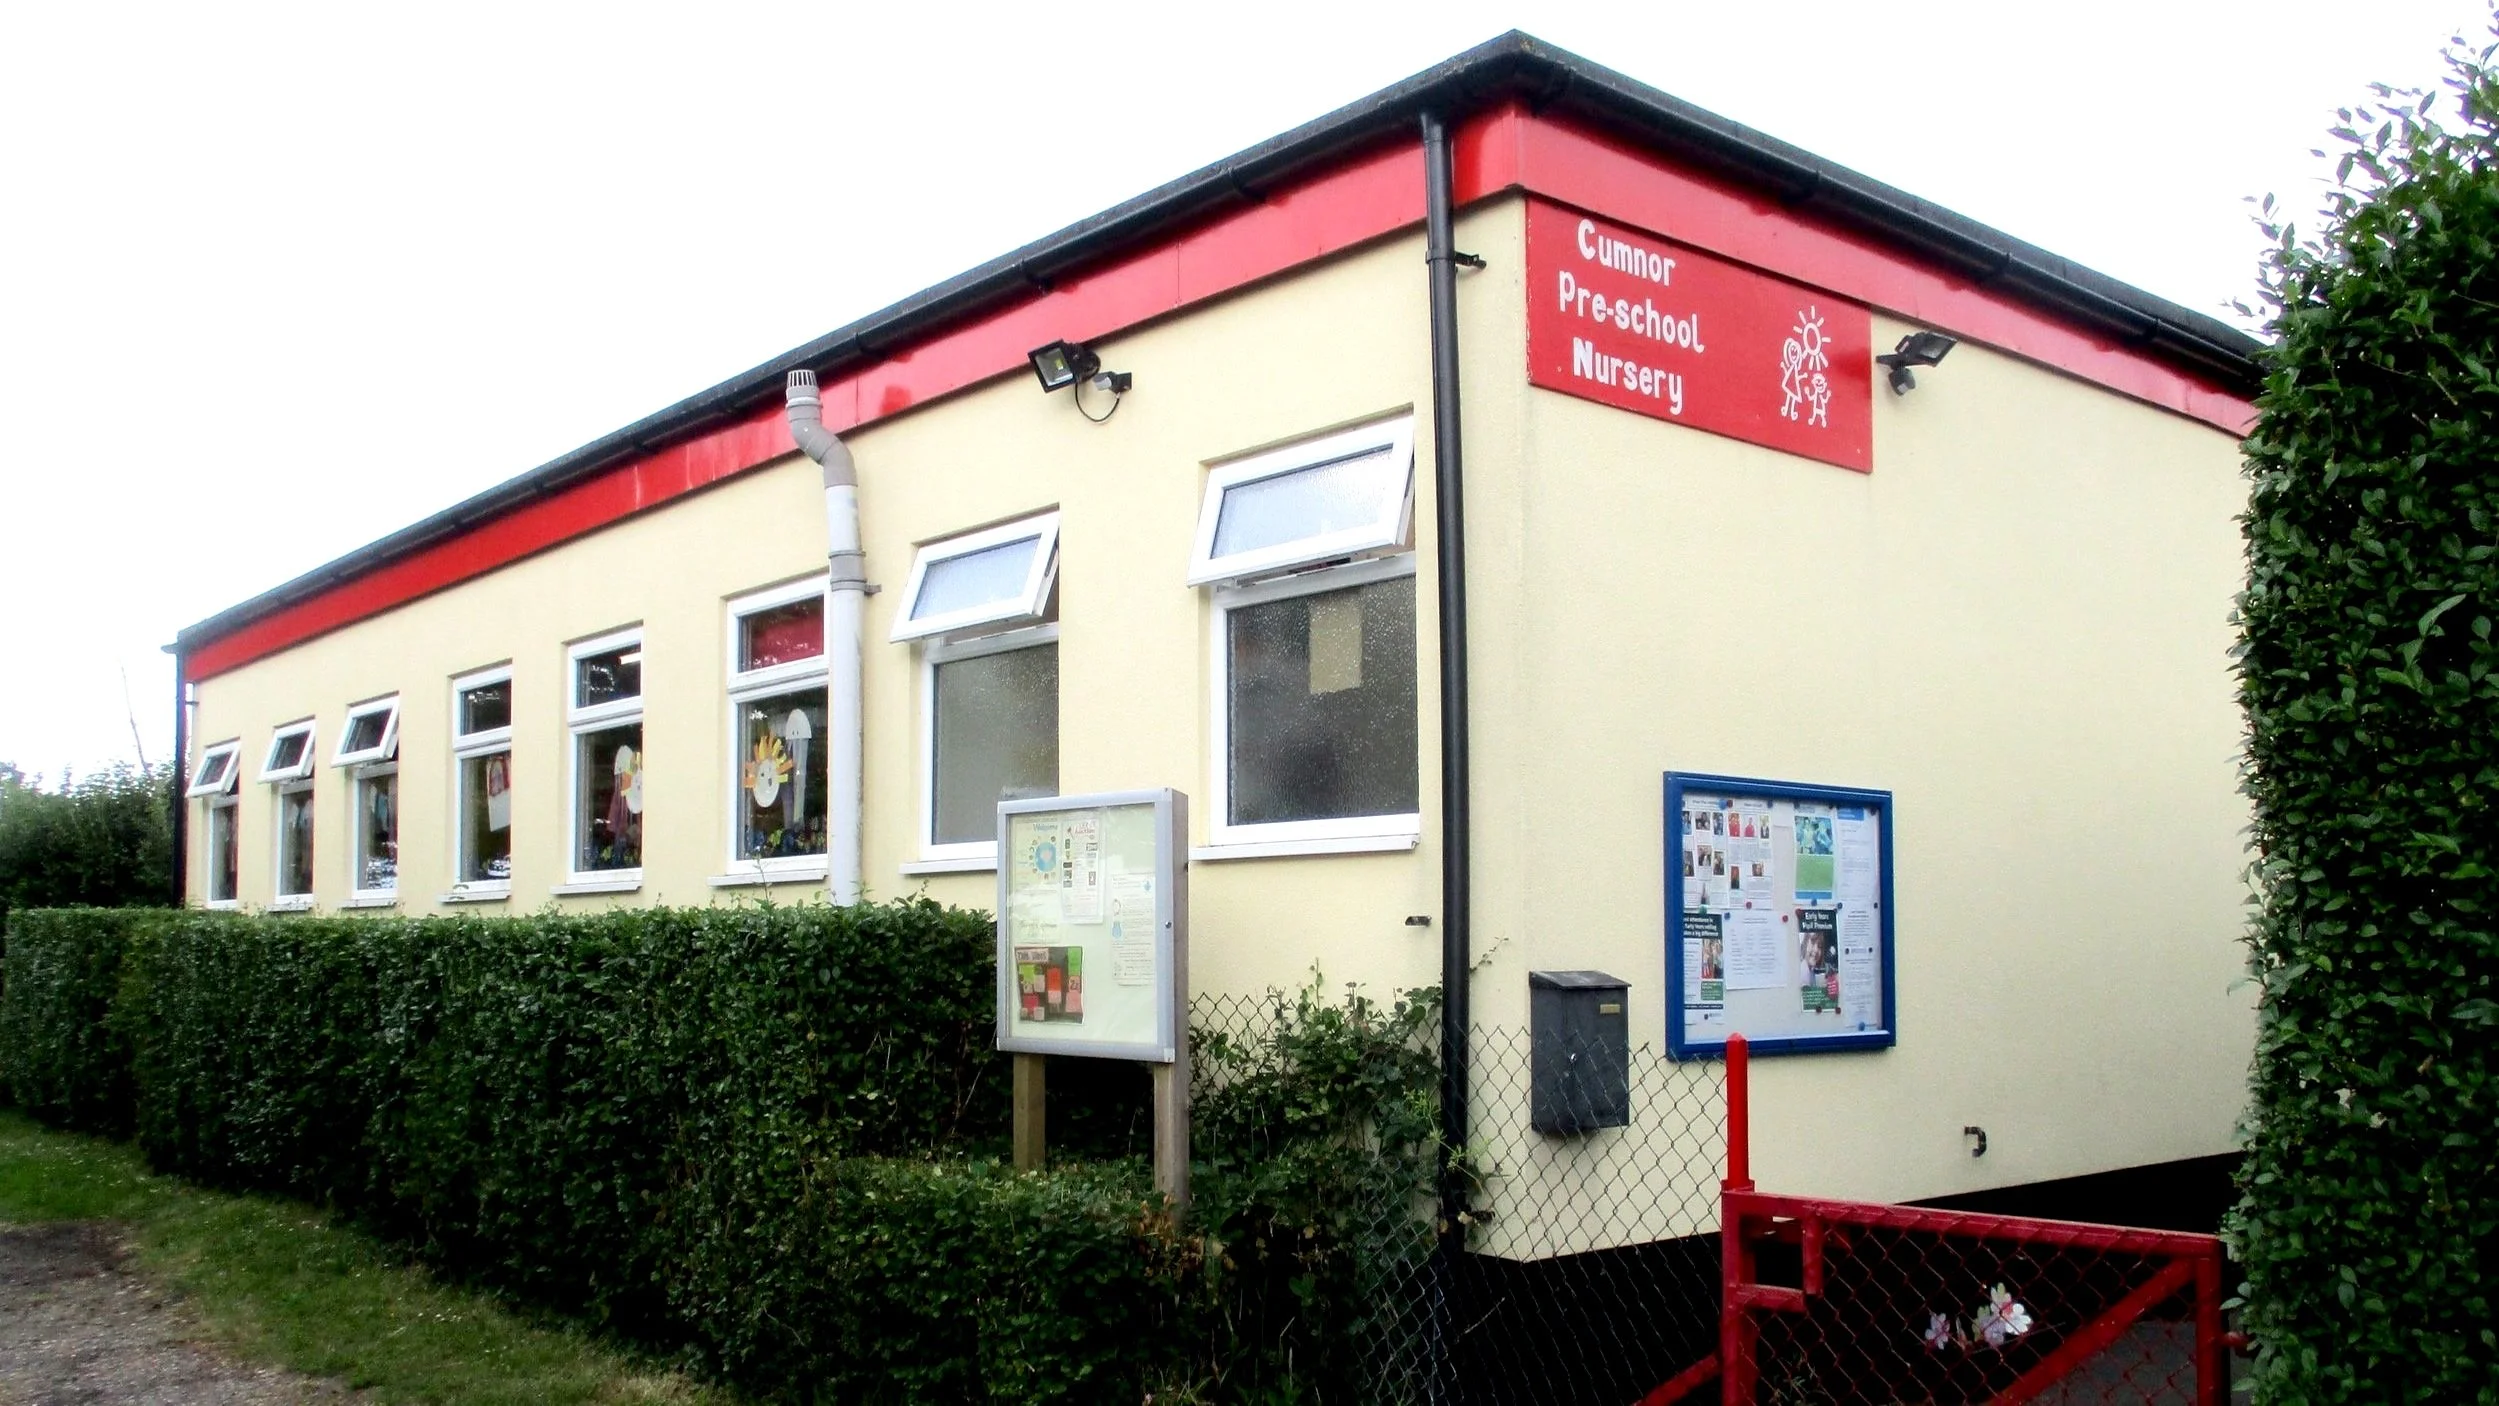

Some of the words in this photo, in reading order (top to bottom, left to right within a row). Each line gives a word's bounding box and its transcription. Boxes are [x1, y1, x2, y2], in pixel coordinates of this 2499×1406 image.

[1577, 218, 1676, 287] Cumnor
[1559, 270, 1705, 353] Pre-school
[1572, 337, 1683, 415] Nursery
